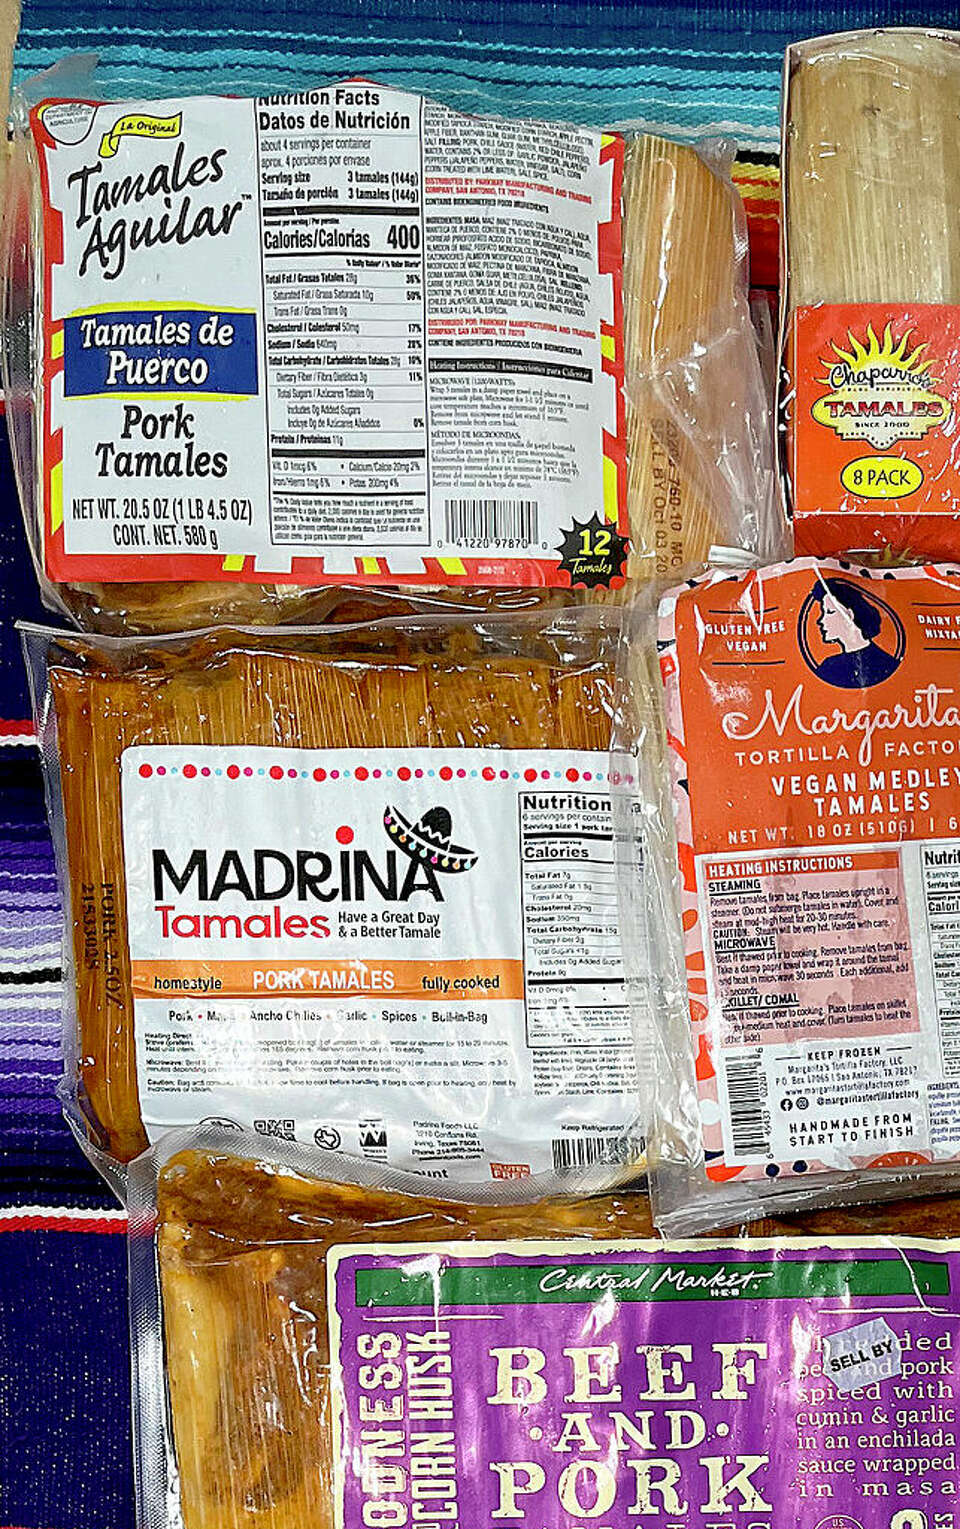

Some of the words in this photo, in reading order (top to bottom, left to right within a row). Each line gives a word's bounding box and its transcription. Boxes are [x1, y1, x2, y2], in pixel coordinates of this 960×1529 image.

[120, 121, 133, 133] La
[137, 120, 176, 135] Original
[260, 111, 304, 130] Datos
[309, 111, 329, 129] de
[335, 109, 410, 130] Nutrición
[69, 143, 228, 228] Tamales
[80, 199, 242, 279] Aguilar
[387, 225, 419, 249] 400
[81, 317, 192, 349] Tamales
[199, 317, 233, 344] de
[106, 352, 208, 385] Puerco
[824, 400, 942, 418] TAMALES
[122, 405, 194, 440] Pork
[95, 443, 228, 478] Tamales
[854, 470, 863, 485] 8
[868, 470, 910, 486] PACK
[113, 525, 150, 547] CONT.
[154, 525, 181, 547] NET.
[184, 525, 206, 547] 580
[209, 529, 218, 550] g
[735, 747, 850, 766] TORTILLA
[772, 773, 857, 795] VEGAN
[814, 792, 931, 817] TAMALES
[709, 862, 763, 879] HEATING
[766, 856, 853, 873] INSTRUCTIONS
[709, 879, 761, 892] STEAMING
[156, 906, 331, 938] Tamales
[338, 912, 365, 924] Have
[372, 915, 378, 924] a
[382, 912, 413, 924] Great
[417, 912, 440, 927] Day
[339, 926, 347, 937] &
[351, 929, 357, 938] a
[361, 926, 396, 938] Better
[399, 926, 440, 938] Tamale
[253, 970, 305, 991] PORK
[311, 970, 394, 991] TAMALES
[789, 1117, 870, 1133] HANDMADE
[875, 1114, 912, 1127] FROM
[789, 1134, 834, 1147] START
[841, 1133, 857, 1143] TO
[862, 1127, 914, 1141] FINISH
[830, 1347, 869, 1374] SELL
[872, 1338, 895, 1359] BY
[486, 1342, 769, 1406] BEEF
[797, 1409, 863, 1427] cumin
[871, 1408, 888, 1425] &
[896, 1406, 954, 1427] garlic
[797, 1430, 817, 1448] in
[825, 1434, 850, 1449] an
[857, 1428, 956, 1448] enchilada
[797, 1458, 854, 1474] sauce
[863, 1454, 955, 1479] wrapped
[489, 1455, 773, 1519] PORK
